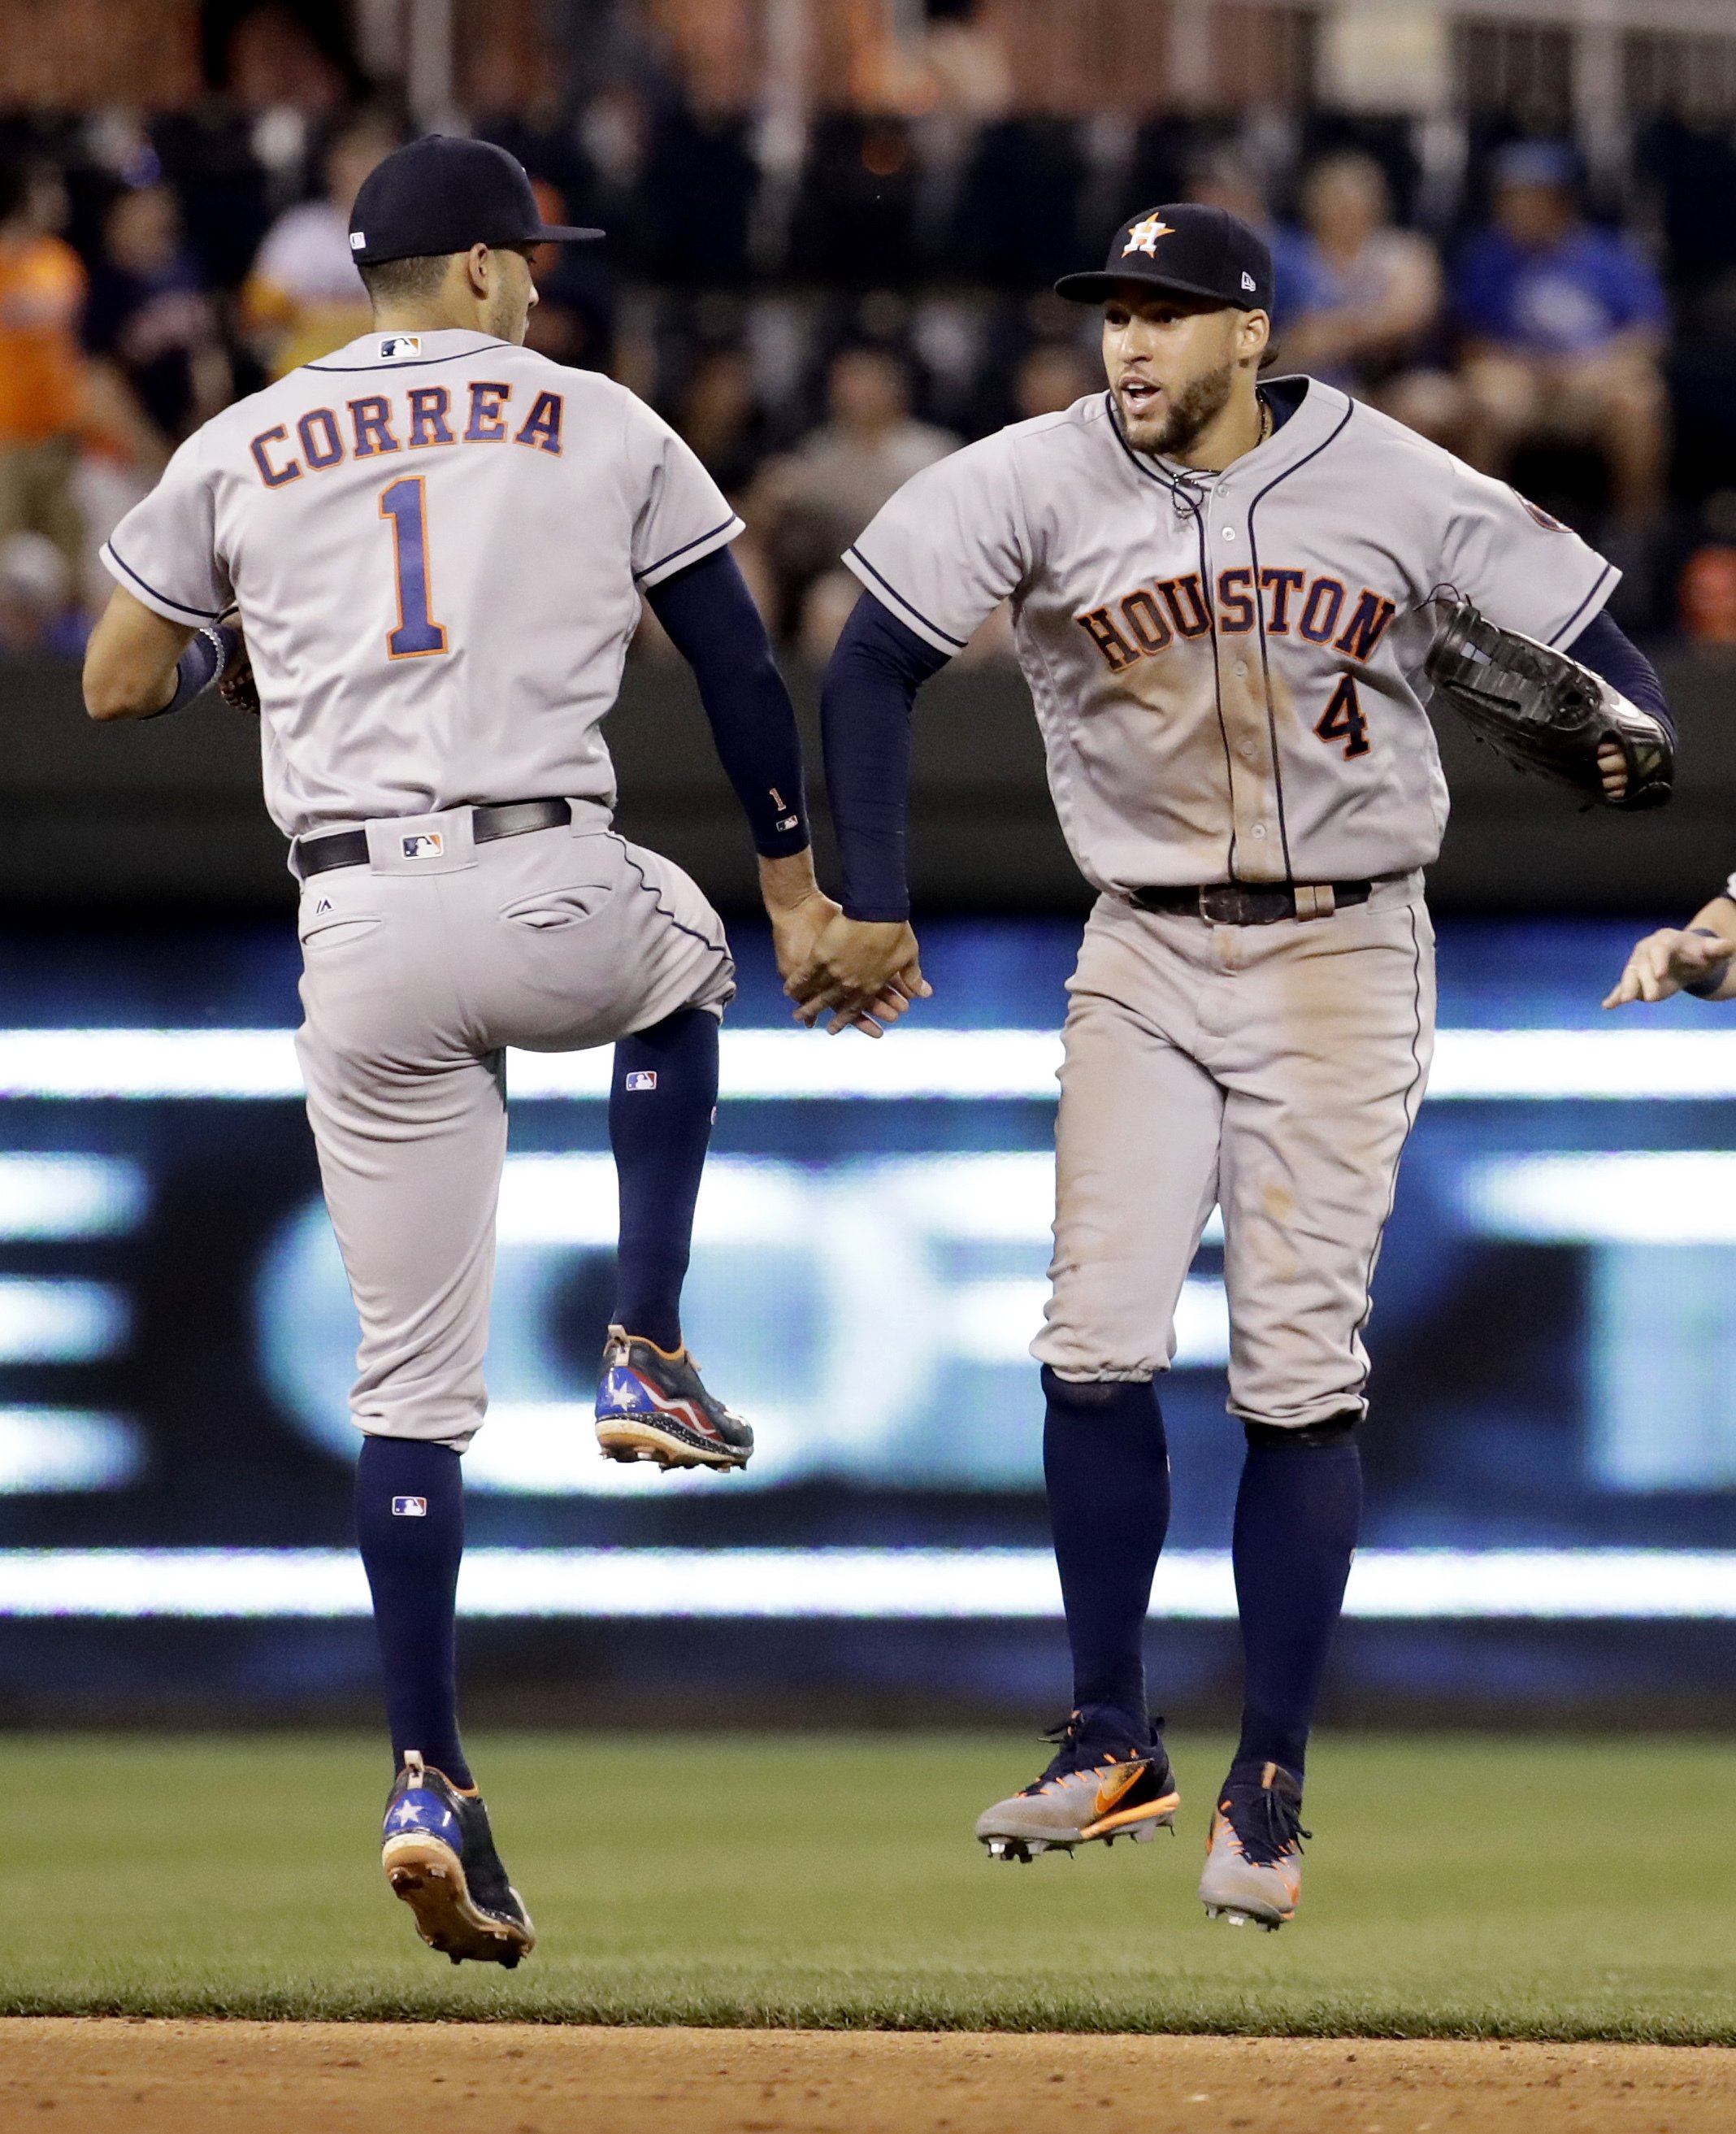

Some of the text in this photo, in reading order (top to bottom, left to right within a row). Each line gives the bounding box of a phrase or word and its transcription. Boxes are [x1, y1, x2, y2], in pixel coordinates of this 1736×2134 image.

[250, 380, 565, 489] CORREA
[379, 475, 449, 661] 1
[1075, 566, 1397, 673] HOUSTON
[1313, 674, 1371, 762] 4
[769, 788, 787, 811] 1
